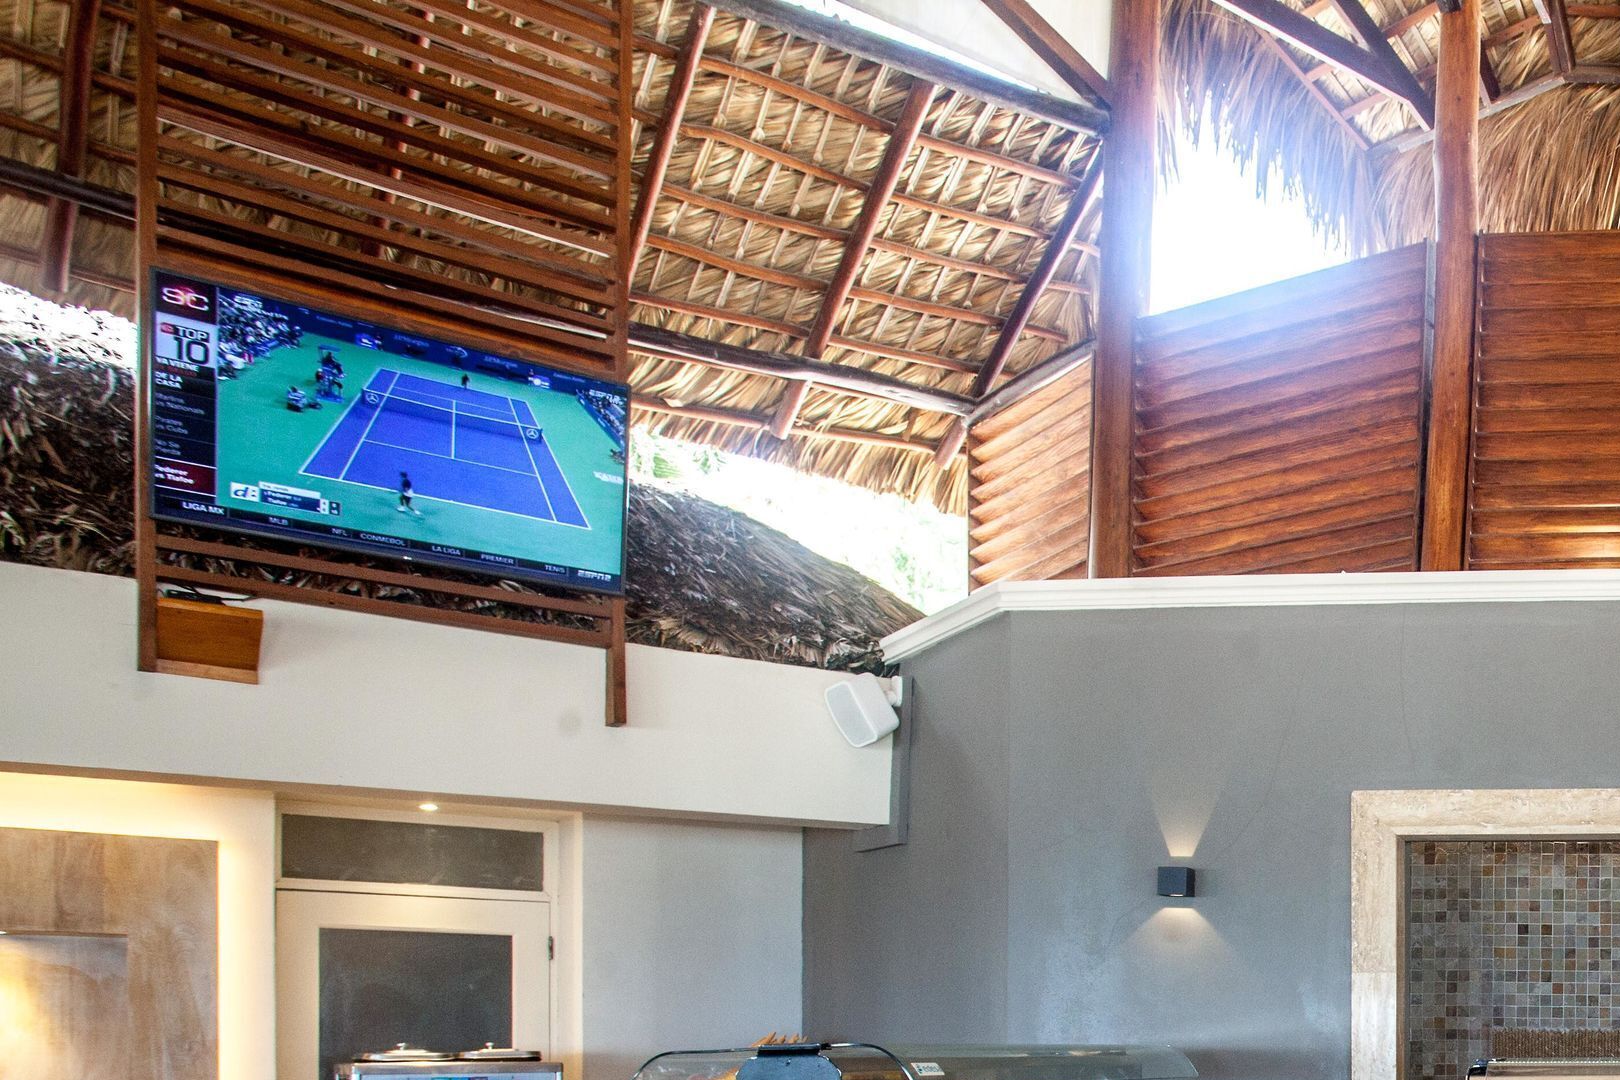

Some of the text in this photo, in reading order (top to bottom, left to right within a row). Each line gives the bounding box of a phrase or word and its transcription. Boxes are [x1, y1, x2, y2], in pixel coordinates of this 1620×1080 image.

[175, 325, 209, 340] TOP
[174, 336, 210, 365] 10
[155, 378, 182, 389] CASA
[182, 501, 225, 516] LIGA MX
[268, 516, 289, 526] MLB
[331, 527, 348, 537] NFL
[360, 532, 406, 547] CONMEBOL
[431, 545, 461, 556] LA LIGA
[480, 553, 514, 565] PREMIER
[544, 564, 566, 574] TENIS
